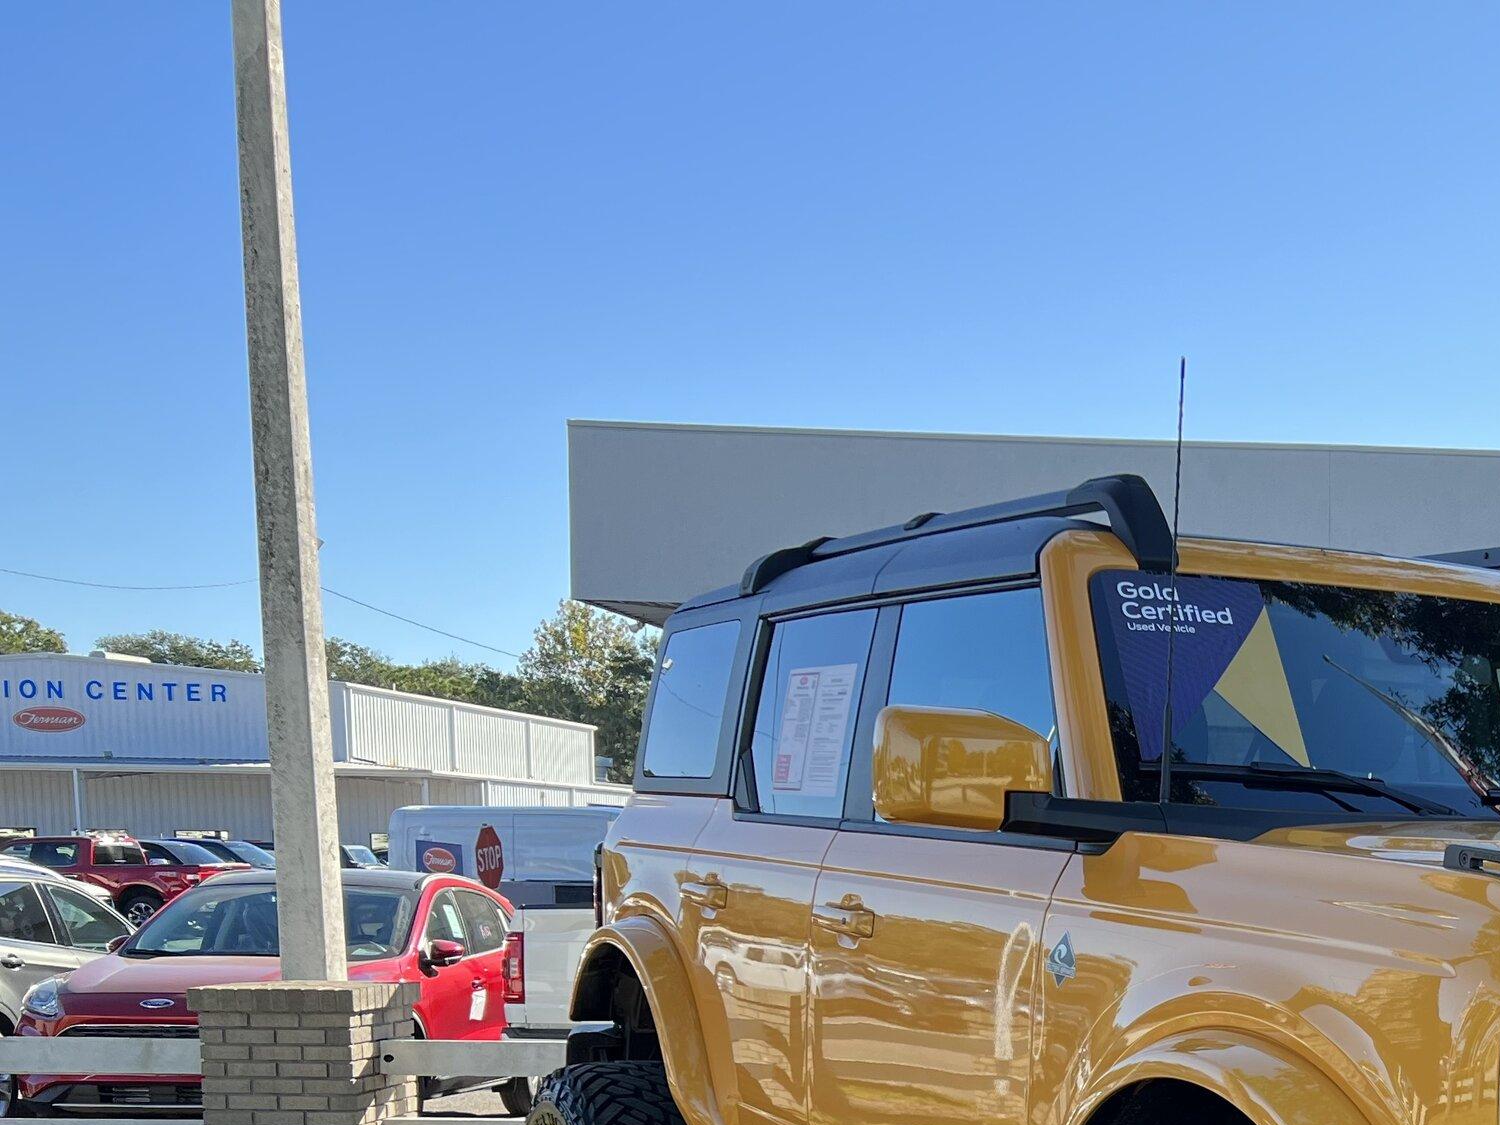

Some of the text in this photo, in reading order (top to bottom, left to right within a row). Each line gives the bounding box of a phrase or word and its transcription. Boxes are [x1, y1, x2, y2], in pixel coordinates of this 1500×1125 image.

[1116, 581, 1180, 602] Gold
[1121, 601, 1234, 625] Certified
[1127, 621, 1156, 632] Used
[3, 679, 228, 702] ION CENTER
[19, 711, 79, 726] Ferman
[477, 844, 502, 873] STOP
